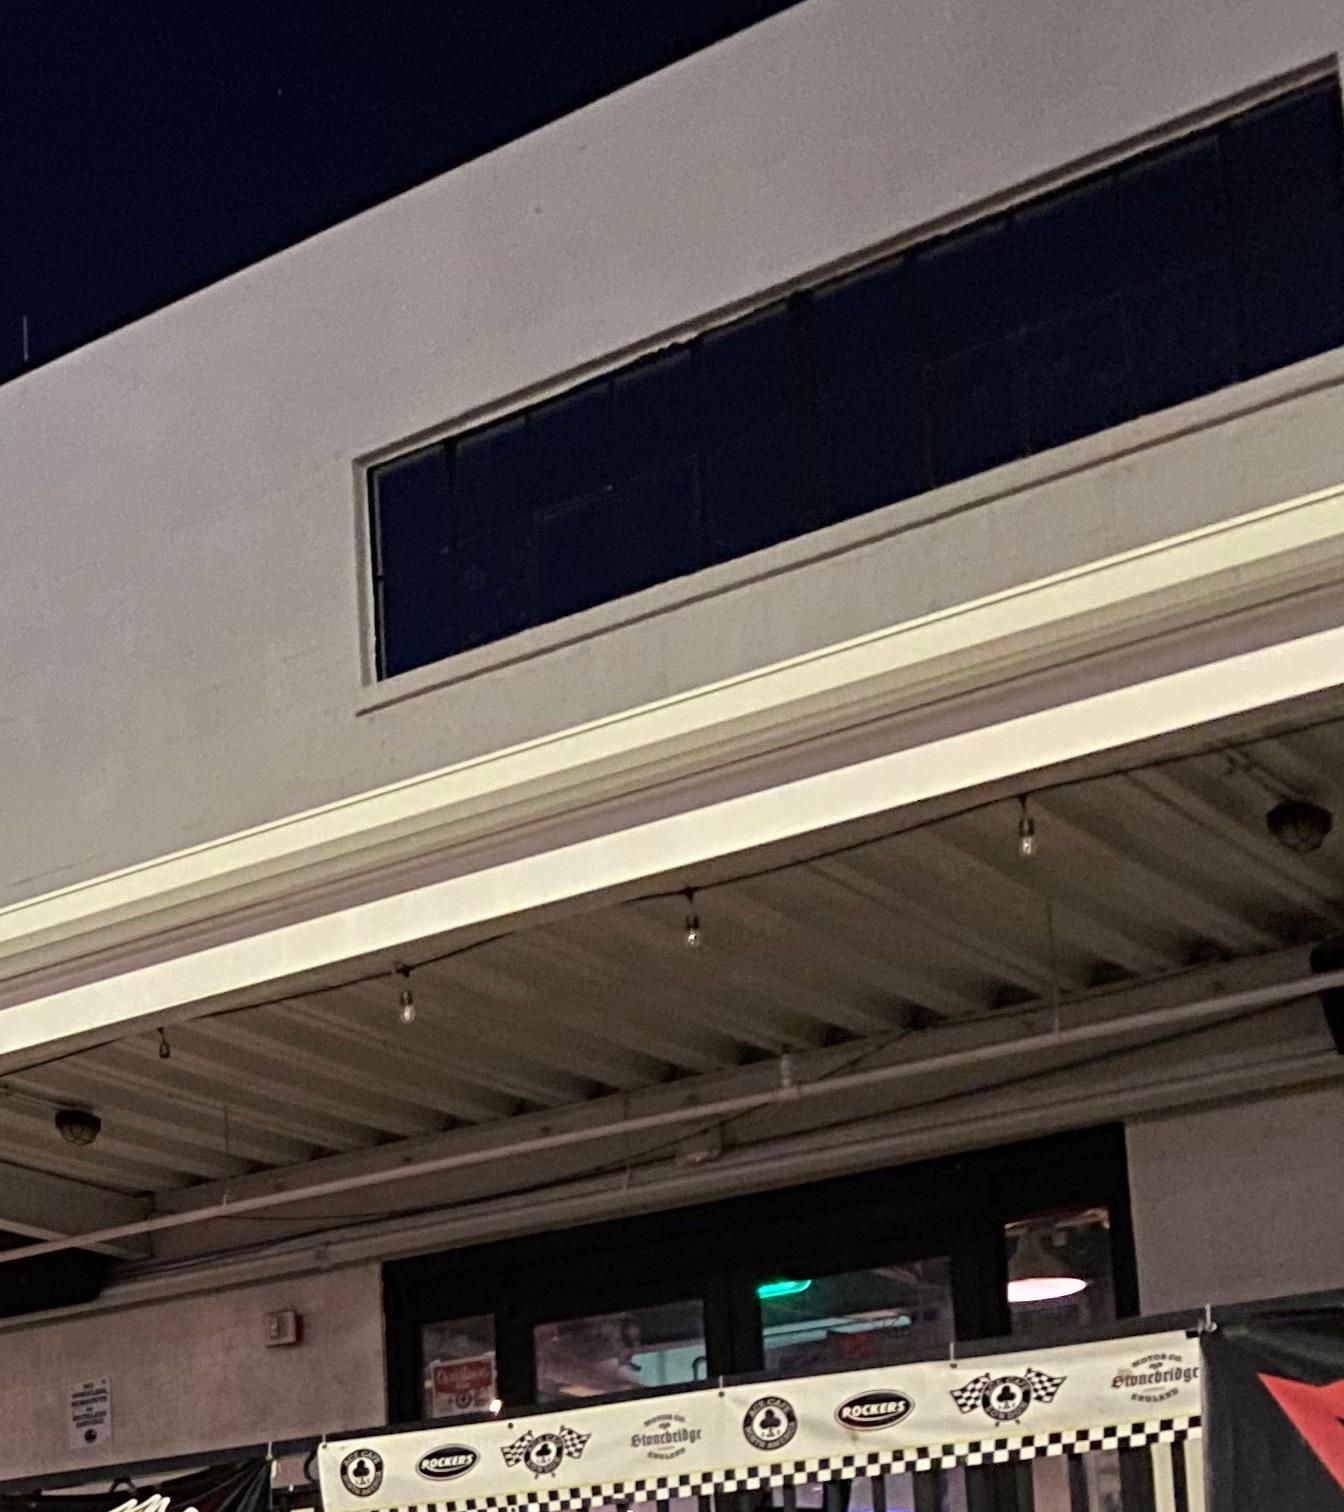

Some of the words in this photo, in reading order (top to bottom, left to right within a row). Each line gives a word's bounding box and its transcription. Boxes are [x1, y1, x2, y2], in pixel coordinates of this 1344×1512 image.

[841, 1400, 908, 1419] ROCKERS
[631, 1428, 702, 1447] Stonebridge
[421, 1453, 474, 1471] ROCKERS
